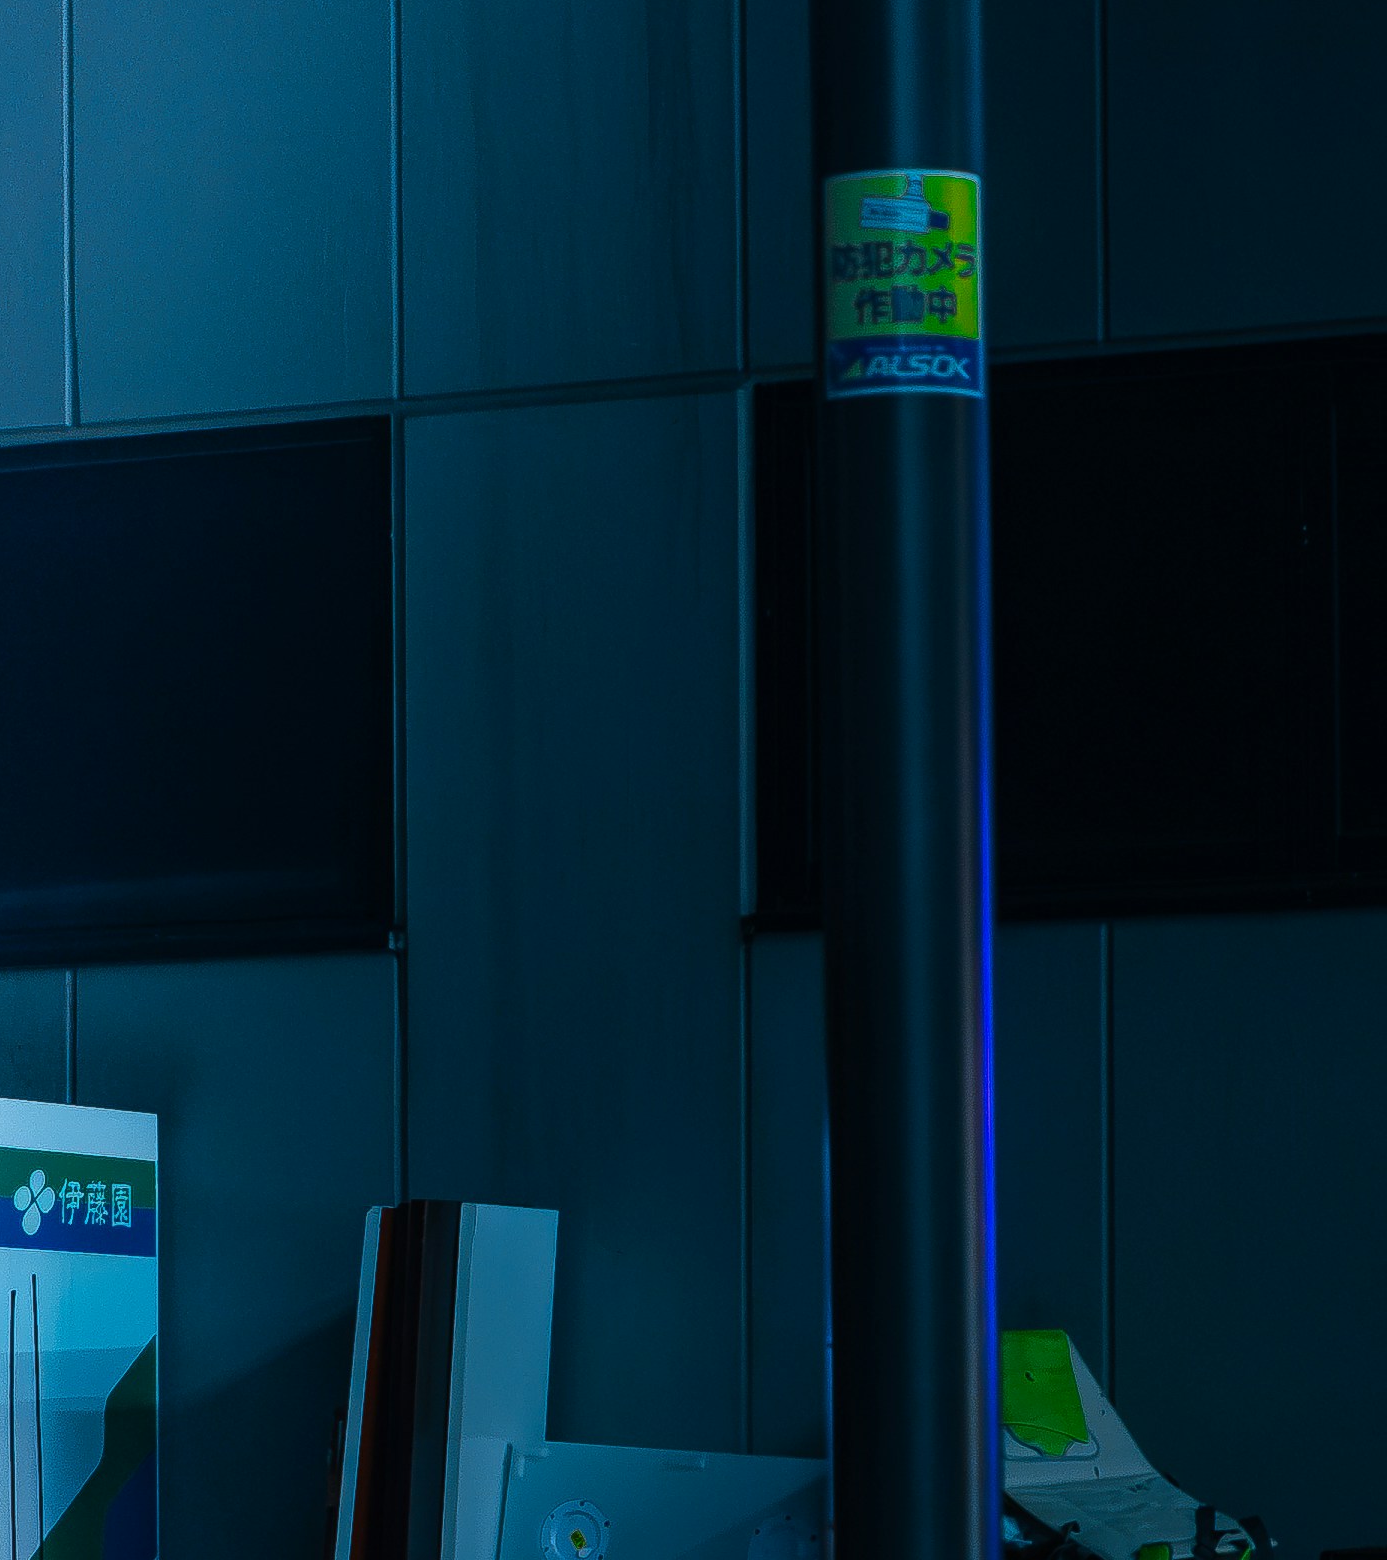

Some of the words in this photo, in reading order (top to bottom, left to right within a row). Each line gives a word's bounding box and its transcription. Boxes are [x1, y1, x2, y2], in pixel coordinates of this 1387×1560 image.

[864, 354, 970, 380] ALSOK
[59, 1178, 132, 1228] 伊藤園
